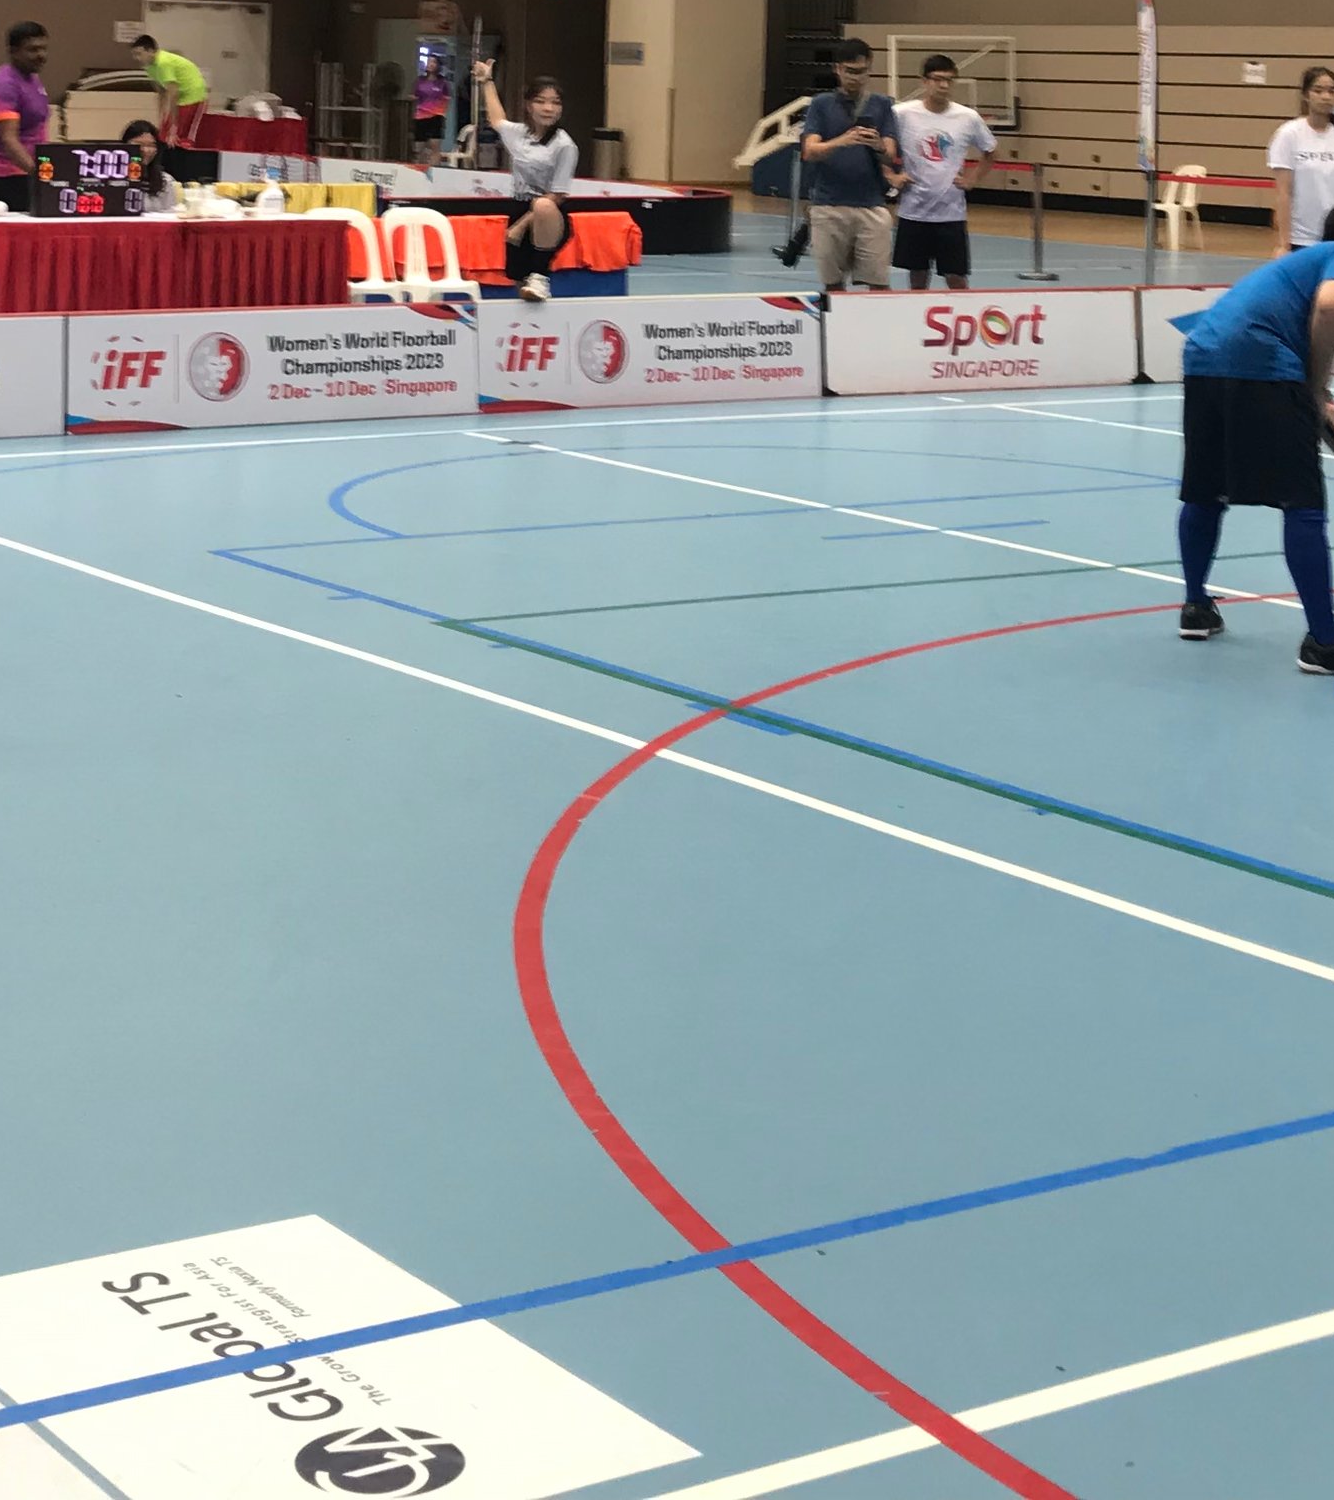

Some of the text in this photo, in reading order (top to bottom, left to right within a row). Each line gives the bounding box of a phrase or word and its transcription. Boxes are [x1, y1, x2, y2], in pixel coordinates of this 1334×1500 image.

[642, 318, 803, 340] Women's World Floorball
[922, 304, 1047, 356] Sport
[267, 329, 457, 353] Women's World Floorball
[655, 341, 793, 363] Championships 2023
[281, 352, 444, 377] Championships 2023
[644, 368, 655, 383] 2
[656, 367, 681, 382] Dec
[709, 366, 735, 380] Dec
[740, 364, 804, 382] Singapore
[930, 358, 1040, 380] SINGAPORE
[268, 384, 280, 401] 2
[282, 383, 312, 399] Dec
[324, 381, 346, 397] 10
[347, 380, 377, 396] Dec
[384, 378, 458, 397] Singapore
[182, 1261, 210, 1283] Asia
[209, 1256, 229, 1268] TS
[102, 1272, 192, 1315] TS
[209, 1282, 238, 1303] For
[264, 1283, 311, 1318] Formerly
[362, 1383, 392, 1406] The
